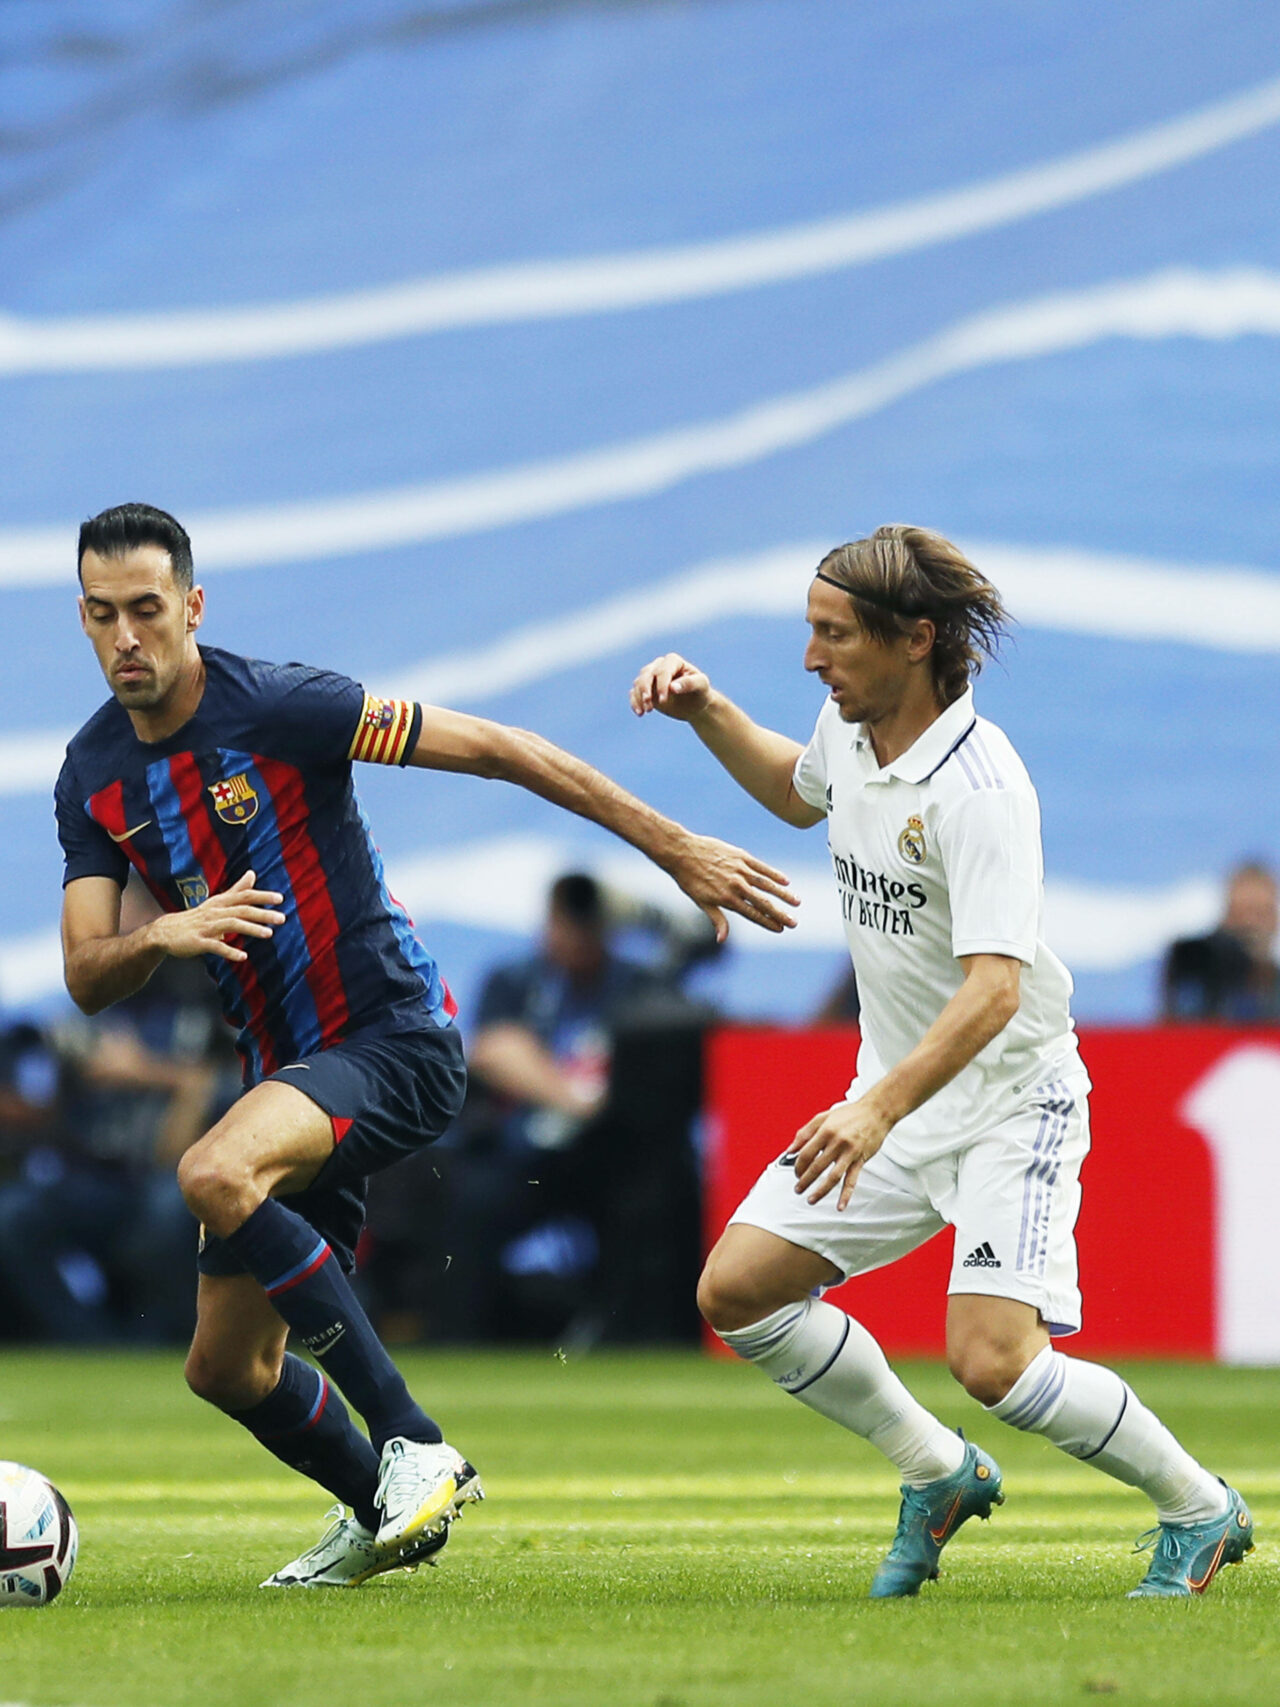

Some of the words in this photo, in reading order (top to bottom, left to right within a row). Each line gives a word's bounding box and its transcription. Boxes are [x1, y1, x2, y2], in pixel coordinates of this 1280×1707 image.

[830, 849, 927, 909] mirates
[838, 888, 854, 921] LY
[858, 897, 914, 935] BETTER
